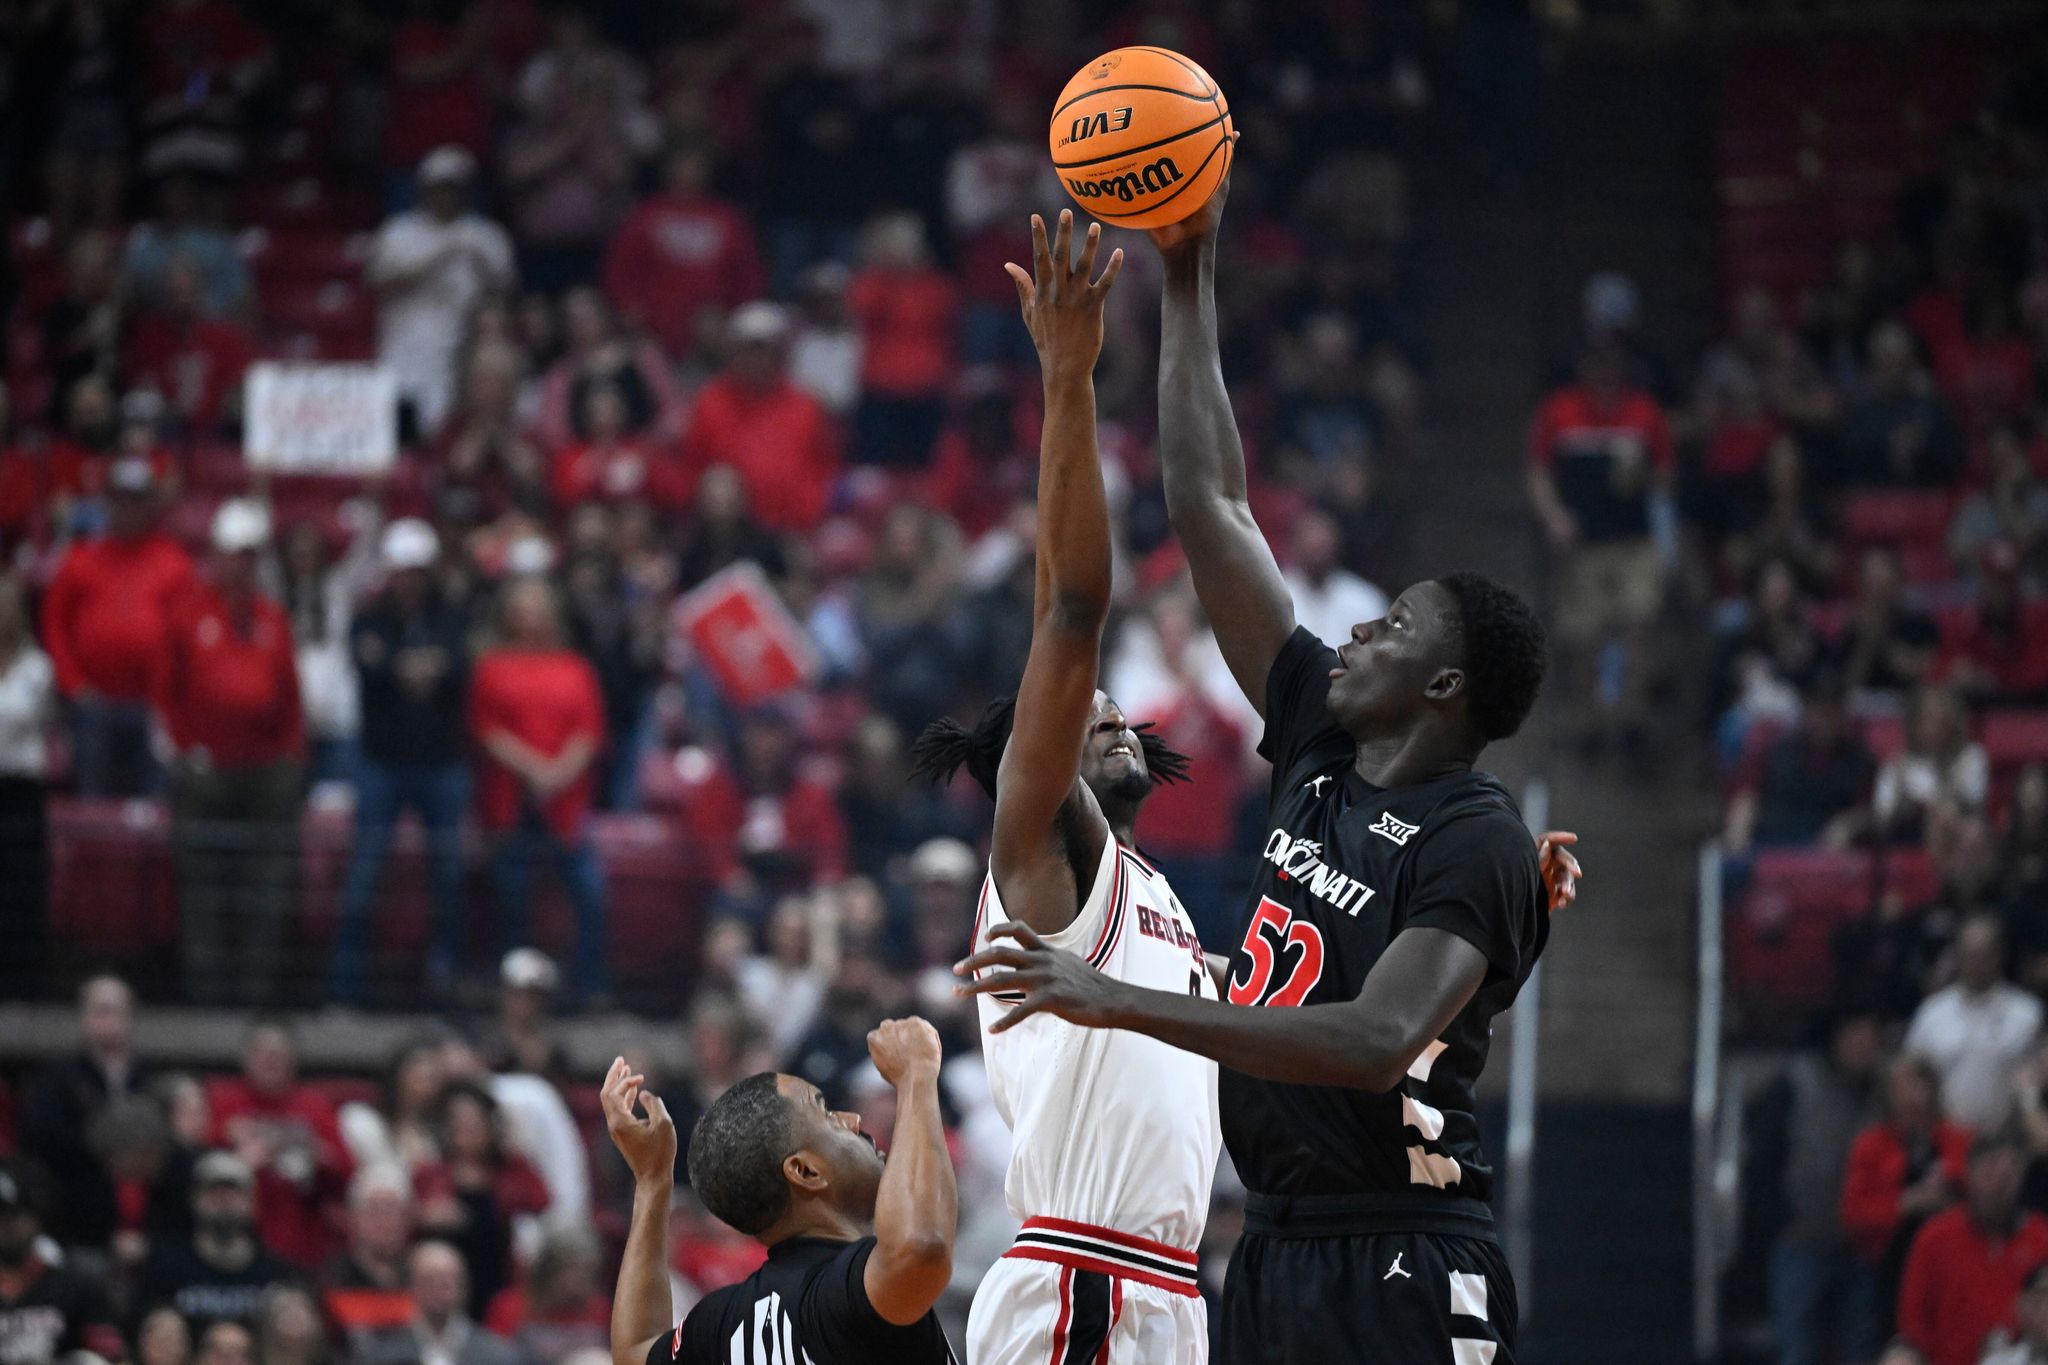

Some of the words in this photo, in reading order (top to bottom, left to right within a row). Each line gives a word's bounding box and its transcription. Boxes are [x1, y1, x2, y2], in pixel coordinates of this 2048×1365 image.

[1058, 136, 1070, 149] NXT
[1070, 106, 1133, 143] EVO
[1066, 156, 1185, 202] Wilson
[1227, 894, 1324, 1007] 52
